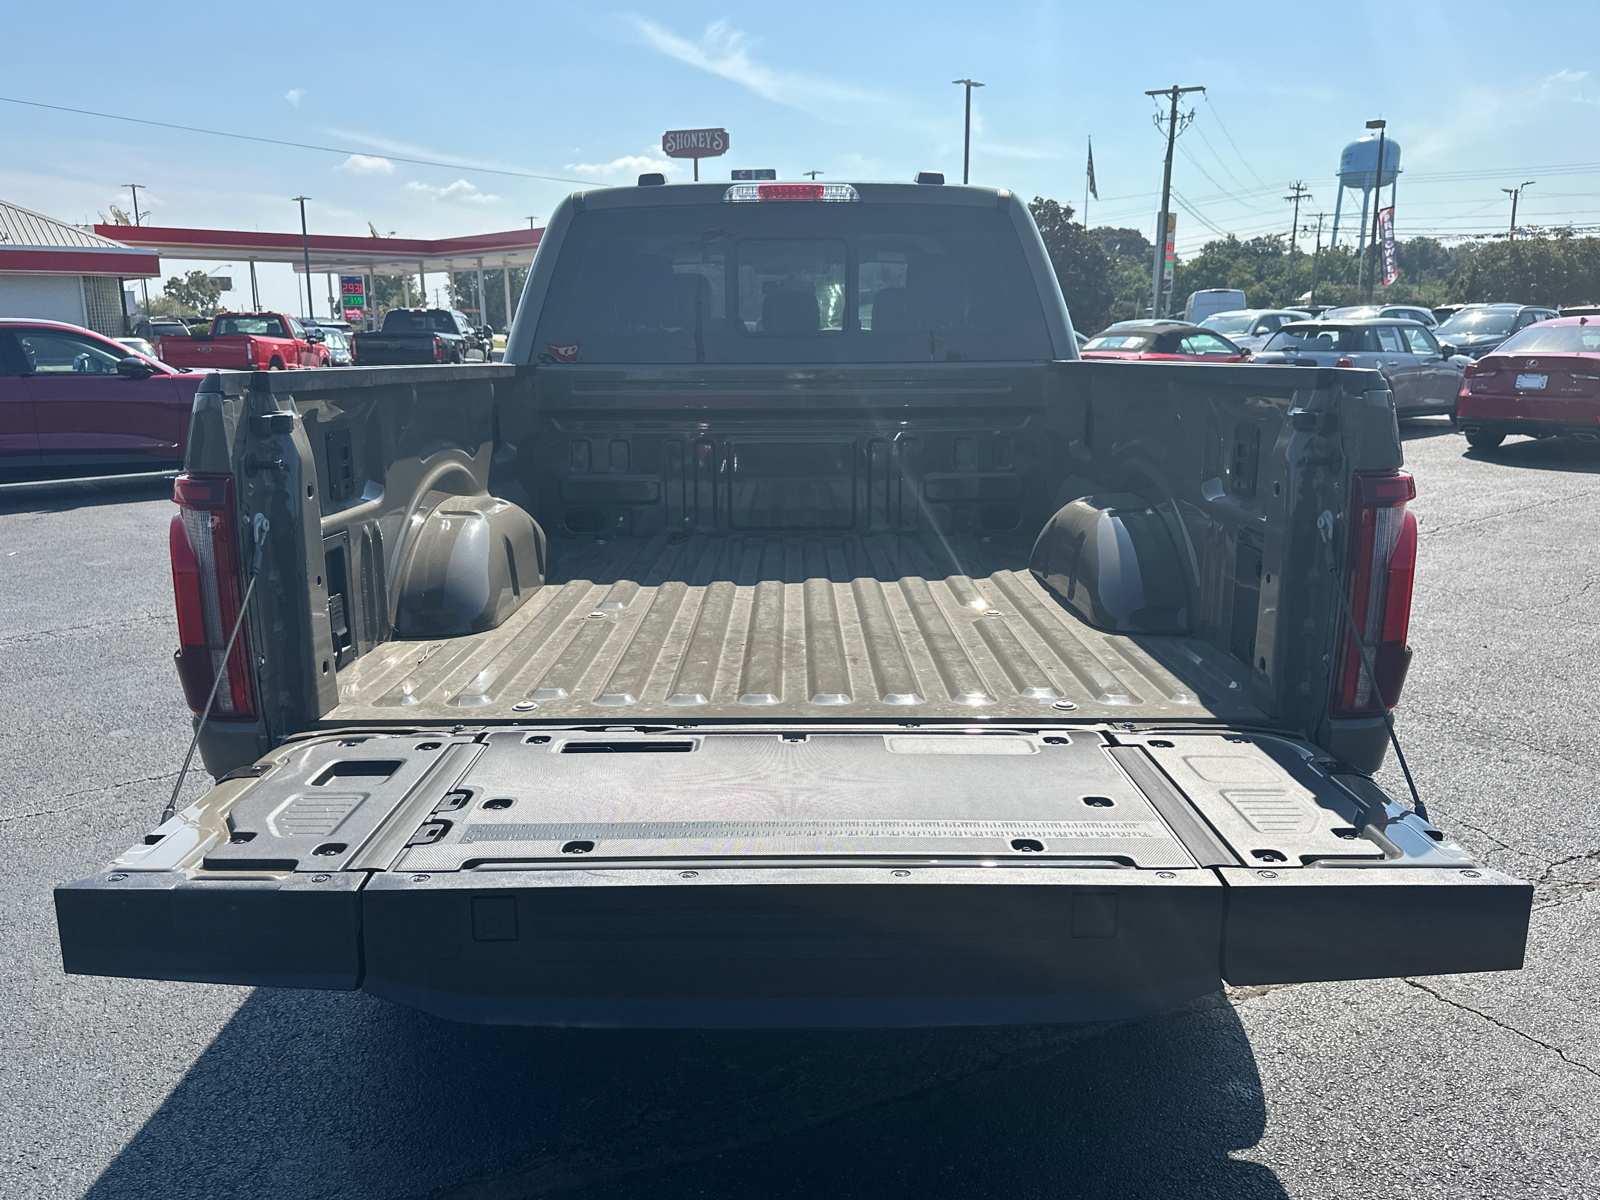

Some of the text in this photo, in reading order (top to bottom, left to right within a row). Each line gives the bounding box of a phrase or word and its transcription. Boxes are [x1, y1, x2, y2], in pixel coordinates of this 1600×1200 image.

[665, 130, 724, 152] SHONEY'S
[1384, 213, 1395, 281] PRE OWNED
